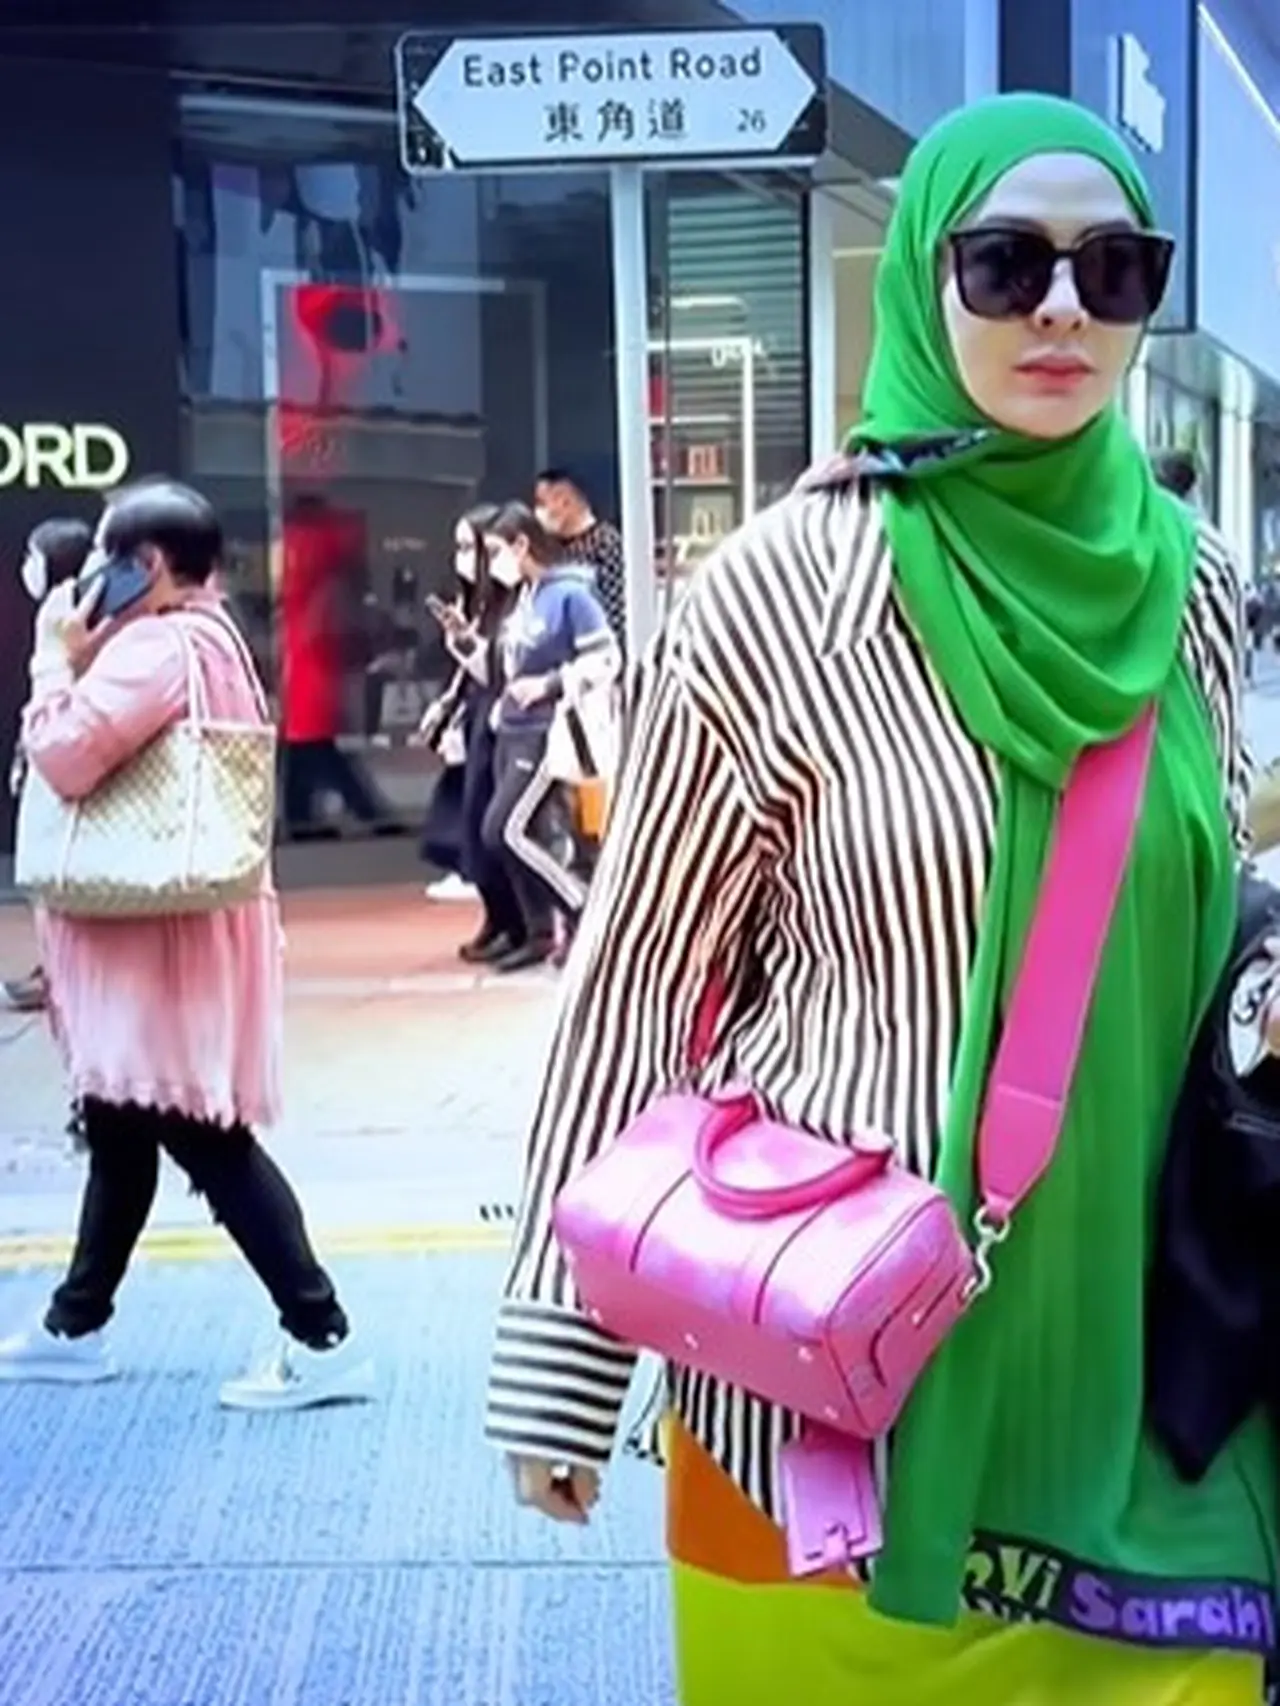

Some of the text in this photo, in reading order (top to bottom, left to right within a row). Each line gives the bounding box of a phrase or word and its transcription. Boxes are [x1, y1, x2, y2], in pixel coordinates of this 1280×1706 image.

[463, 47, 762, 88] East Point Road
[543, 98, 768, 143] 東角道 26
